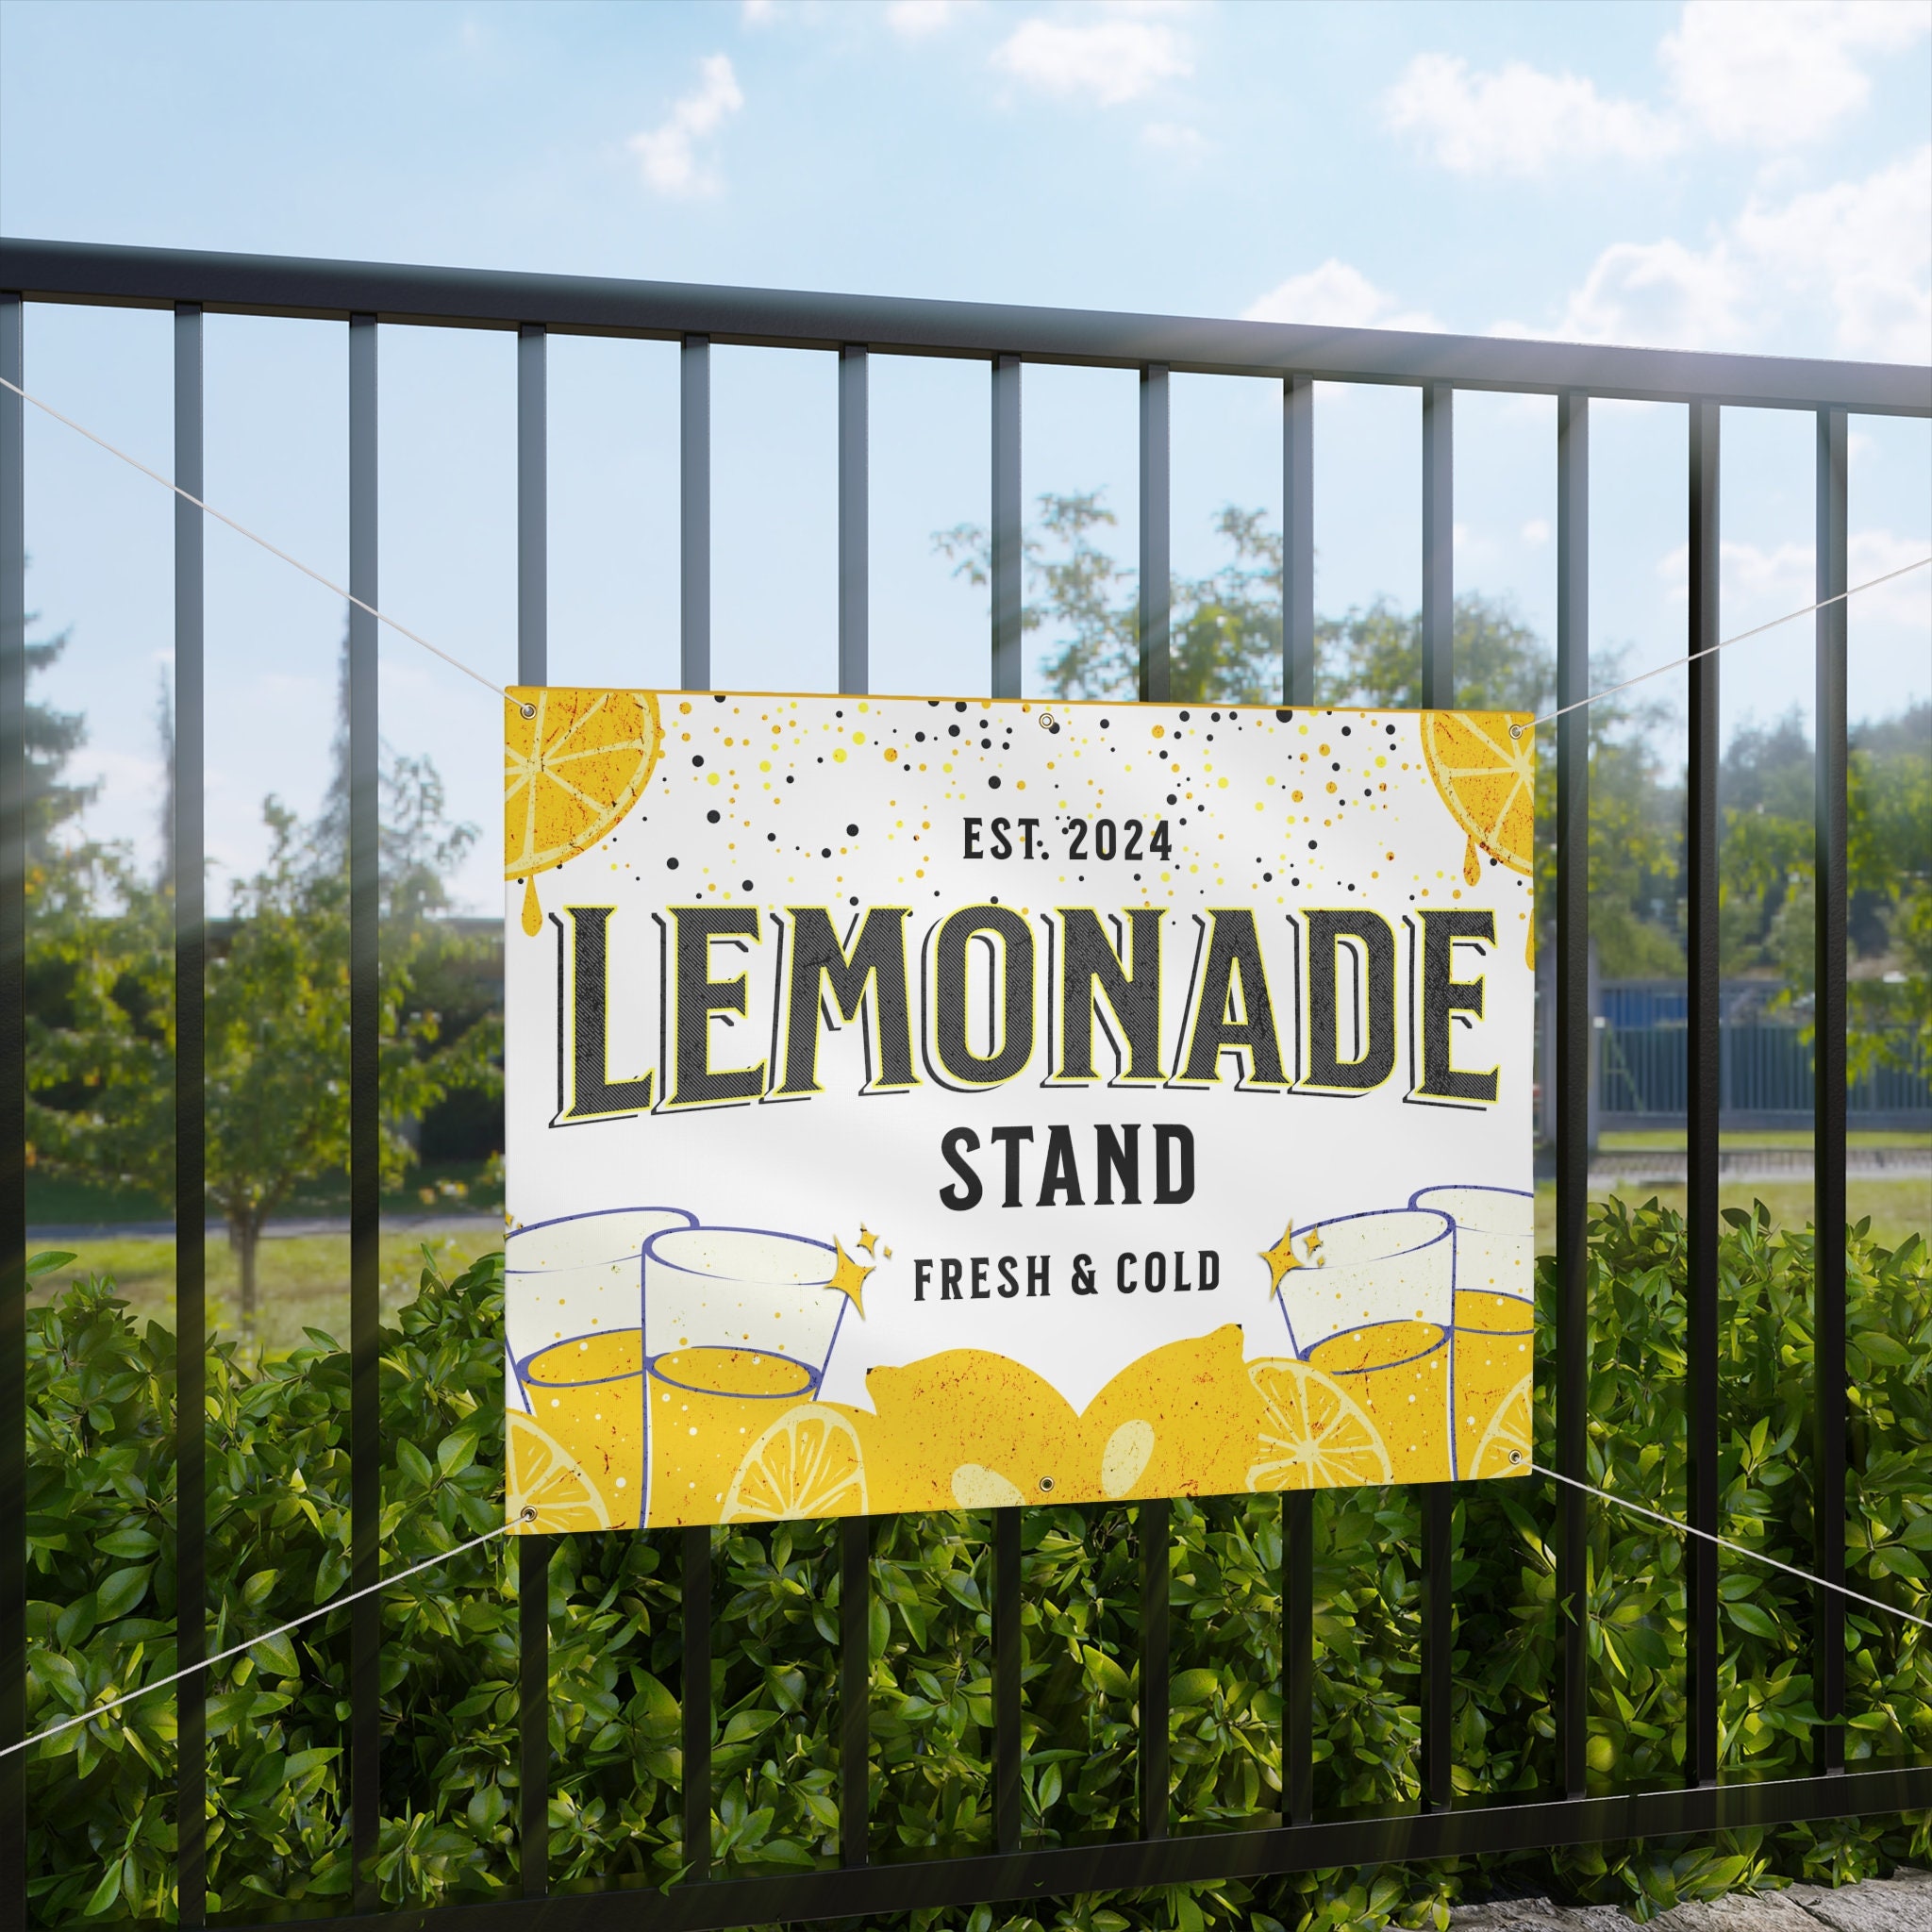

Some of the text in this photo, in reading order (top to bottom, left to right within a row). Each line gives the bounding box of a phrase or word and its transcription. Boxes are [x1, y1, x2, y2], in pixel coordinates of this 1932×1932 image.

[1067, 818, 1173, 862] 2024
[549, 905, 1501, 1128] LEMONADE
[938, 1124, 1196, 1212] STAND
[913, 1250, 1220, 1302] FRESH & COLD
